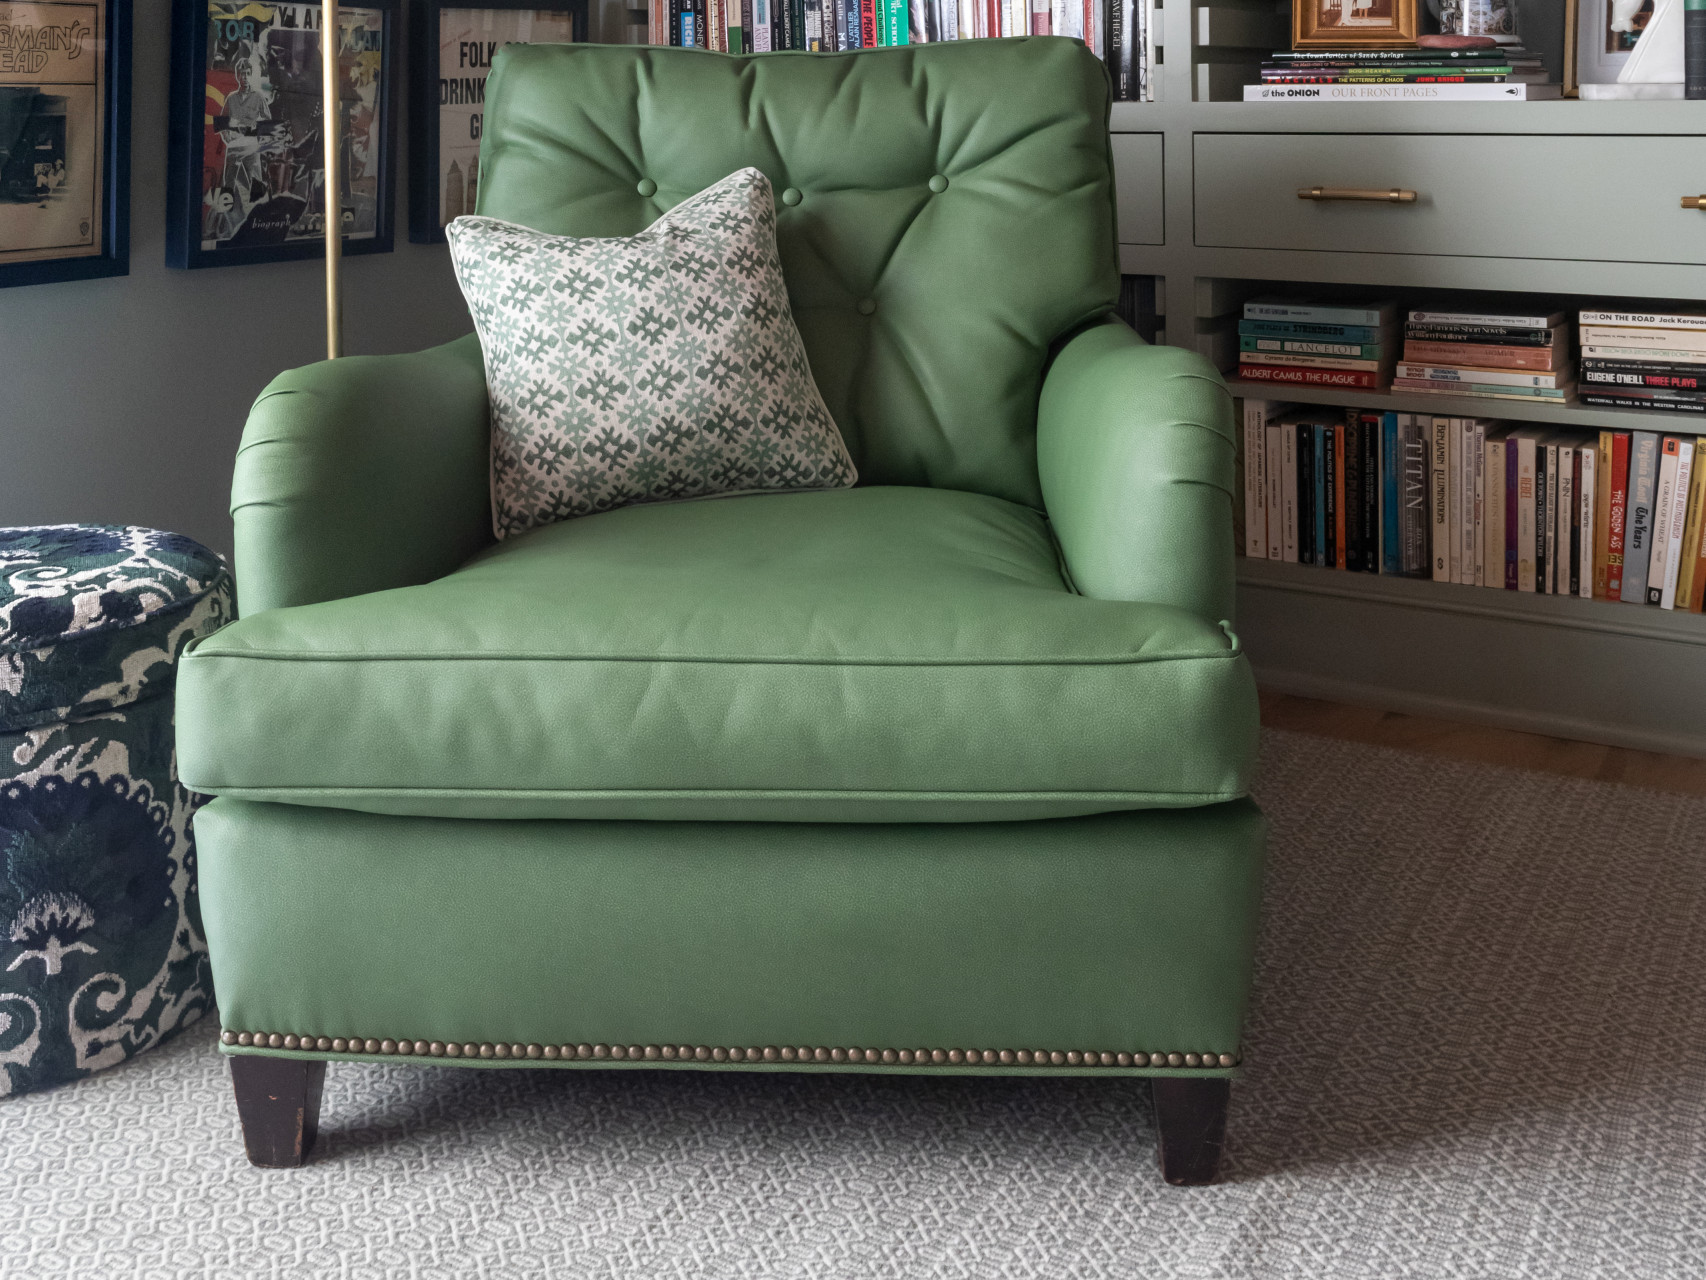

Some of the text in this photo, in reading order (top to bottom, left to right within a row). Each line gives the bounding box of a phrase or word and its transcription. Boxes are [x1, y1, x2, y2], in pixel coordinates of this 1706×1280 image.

[862, 0, 871, 15] THE
[864, 16, 873, 47] PEOPLE
[1331, 88, 1350, 97] OUR
[1360, 88, 1400, 97] FRONT
[1403, 88, 1438, 97] PAGES
[251, 214, 292, 230] biograph
[1290, 342, 1355, 355] LANCELOT
[1242, 369, 1355, 385] ALBERT CAMUS THE PLAGUE
[1587, 372, 1697, 388] EUGENE O'NEILL THREE PLAYS
[1405, 438, 1423, 510] TITAN
[1434, 425, 1446, 524] BENJAMIN ILLUMINATIONS
[1521, 477, 1531, 498] REBEL
[1562, 478, 1570, 497] PNIN
[1610, 490, 1623, 548] THE GOLDEN ASS
[1633, 507, 1648, 549] The Years
